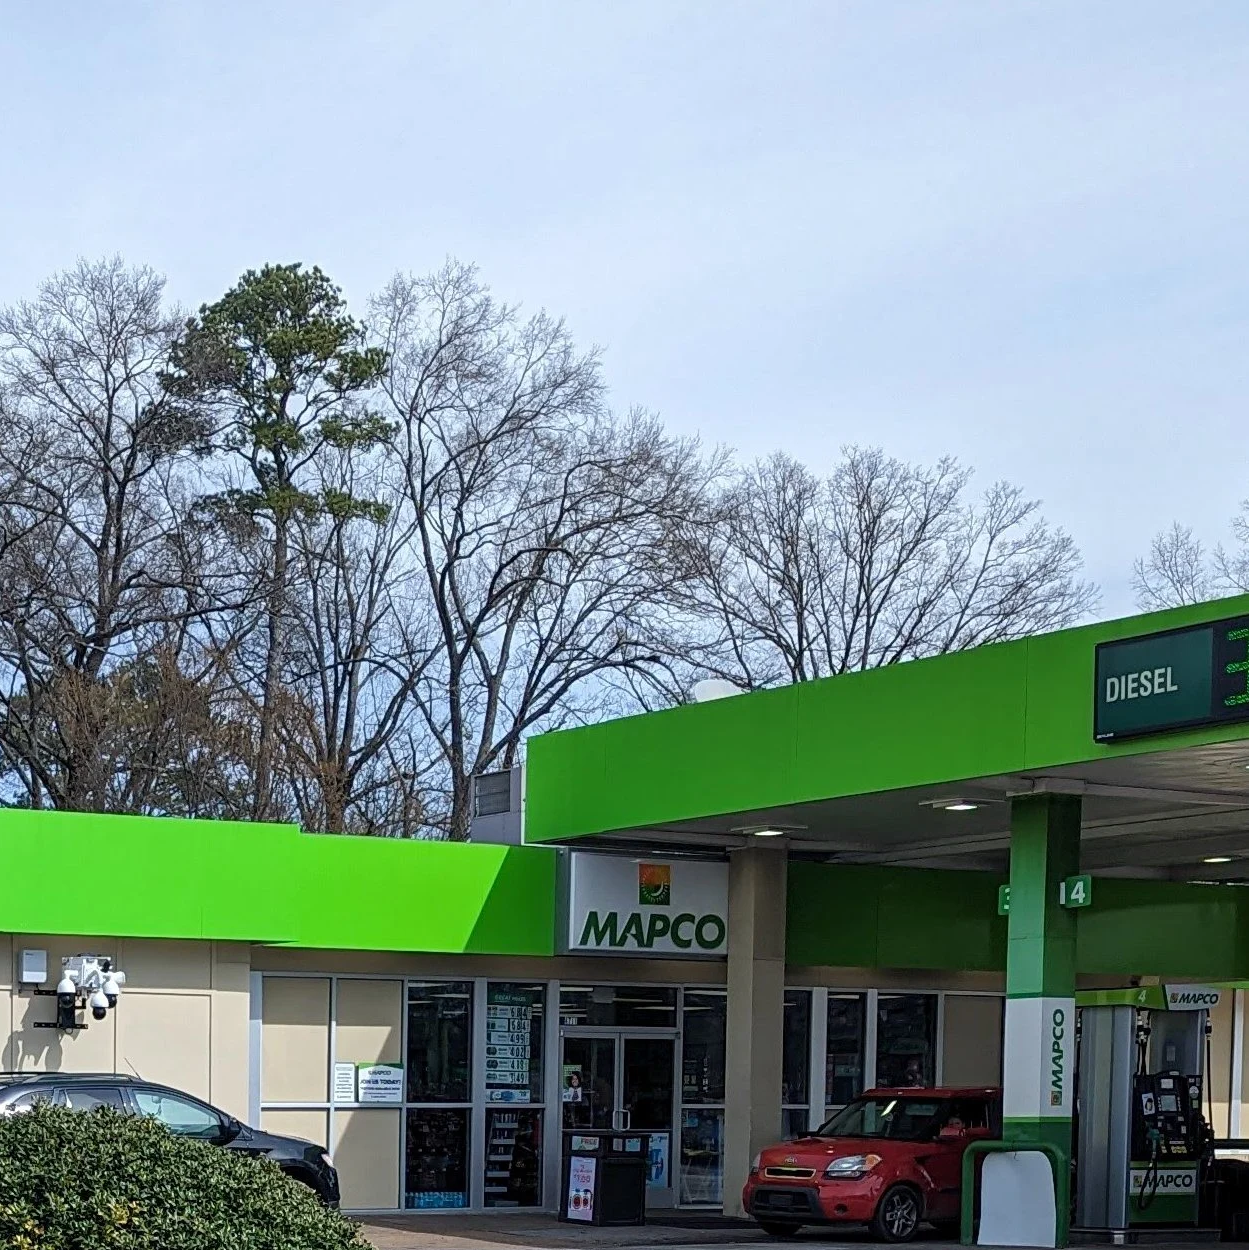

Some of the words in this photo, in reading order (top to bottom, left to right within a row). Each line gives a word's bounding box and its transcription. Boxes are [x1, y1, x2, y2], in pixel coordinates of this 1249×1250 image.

[1105, 666, 1179, 703] DIESEL
[1071, 881, 1086, 904] 4
[578, 911, 726, 950] MAPCO
[1138, 990, 1147, 1003] 4
[1178, 992, 1219, 1005] MAPCO
[1051, 1008, 1065, 1090] MAPCO
[1147, 1174, 1193, 1187] MAPCO
